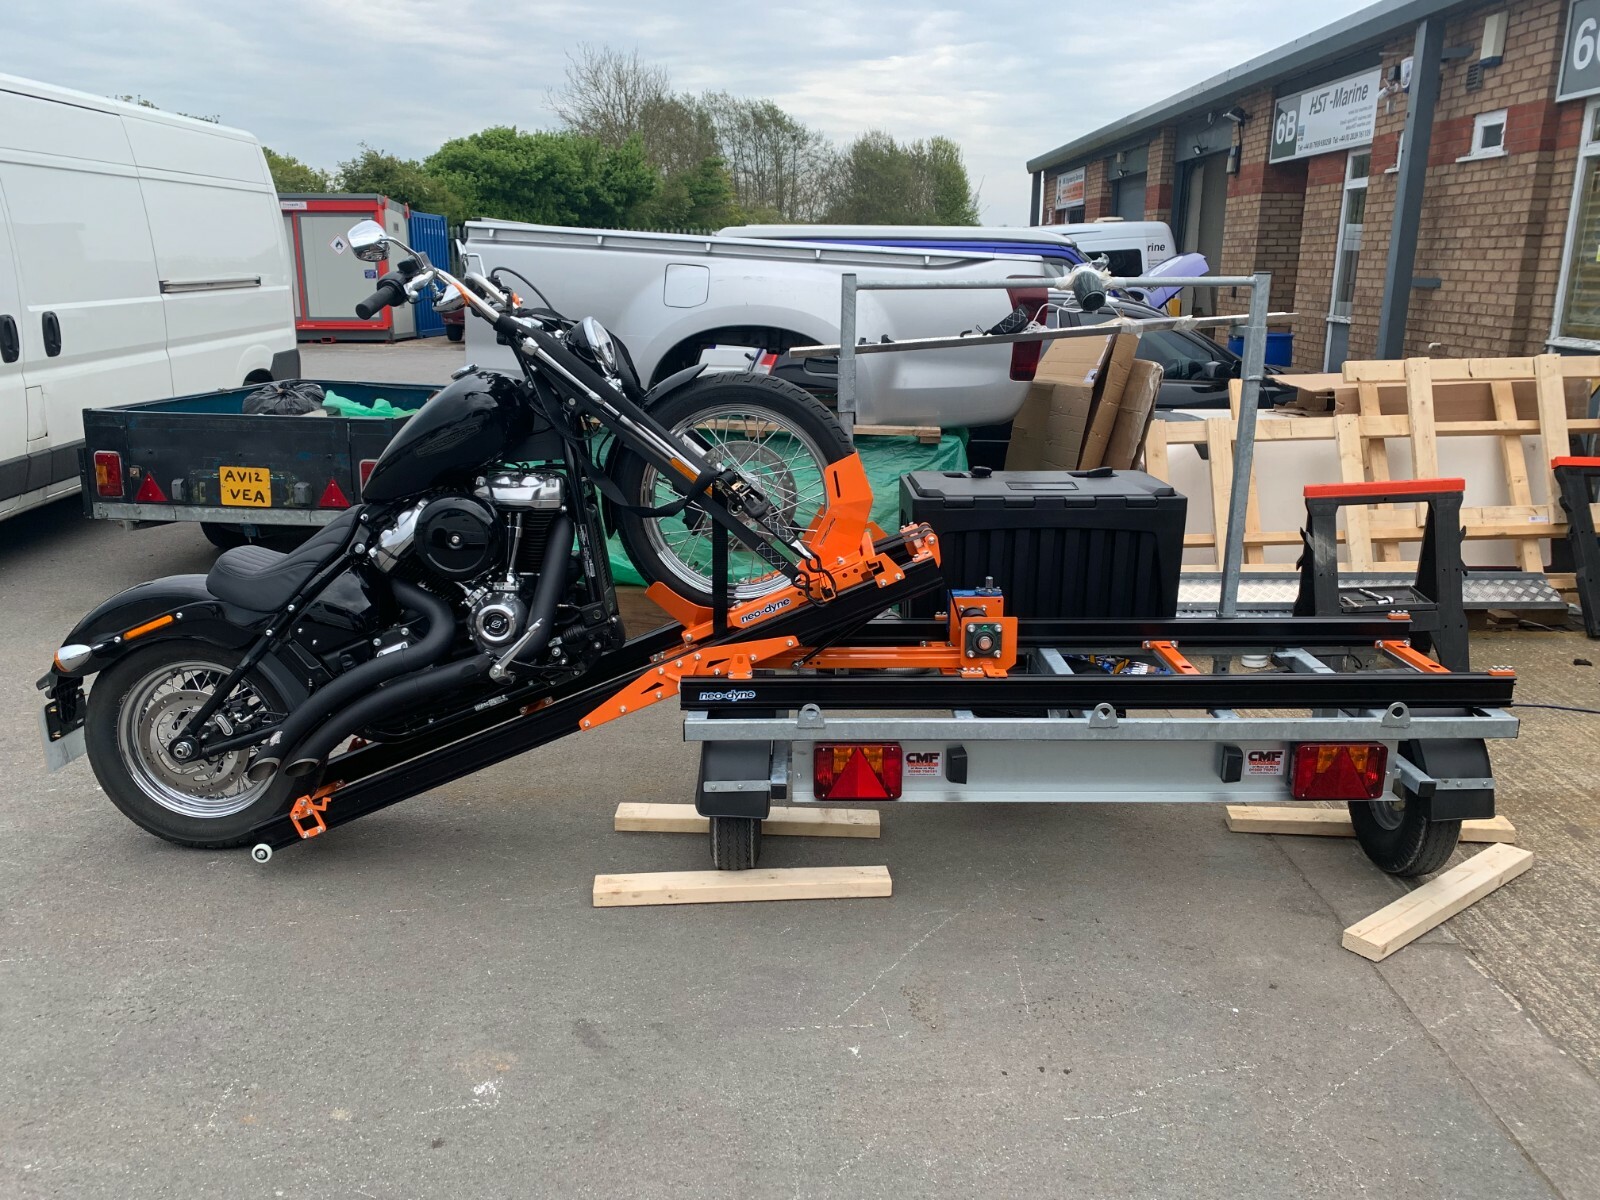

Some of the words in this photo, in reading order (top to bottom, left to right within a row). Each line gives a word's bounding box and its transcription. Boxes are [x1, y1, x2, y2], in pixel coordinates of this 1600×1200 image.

[1573, 17, 1600, 70] 6
[1276, 110, 1297, 145] 6B
[1147, 243, 1166, 252] rine
[229, 488, 265, 504] VEA
[741, 598, 791, 624] neo-dyne
[699, 690, 756, 702] neo-dyne
[906, 752, 940, 763] CMF
[1248, 751, 1283, 761] CMF
